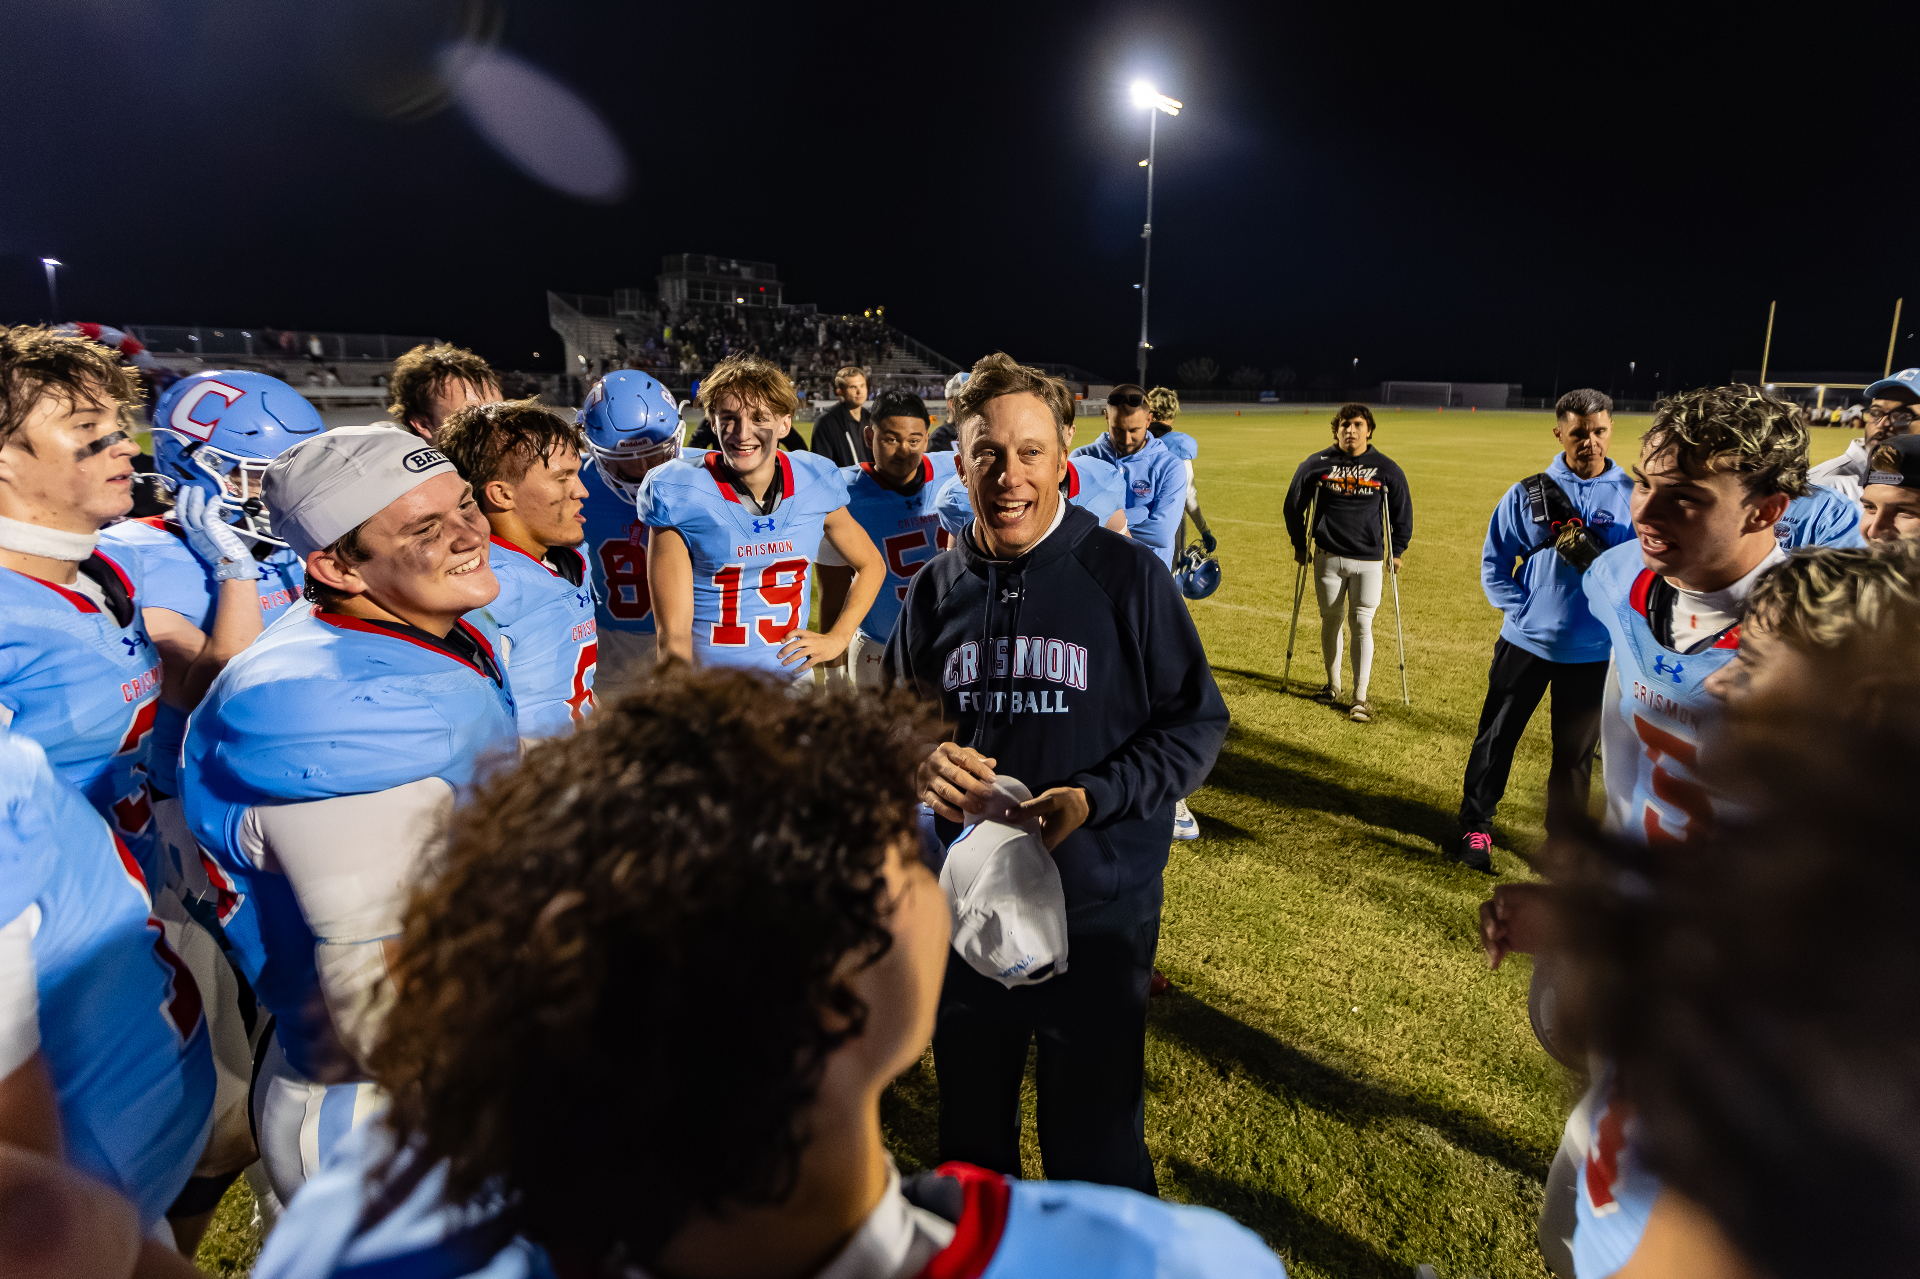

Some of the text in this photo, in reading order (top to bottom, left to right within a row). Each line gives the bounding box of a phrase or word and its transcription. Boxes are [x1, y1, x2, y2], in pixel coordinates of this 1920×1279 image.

[170, 379, 247, 443] C
[620, 438, 648, 448] Riddell
[898, 512, 940, 529] CRISMON
[737, 540, 793, 558] CRISMON
[710, 555, 812, 647] 19
[943, 635, 1088, 692] CRISMON
[957, 690, 1069, 714] FOOTBALL
